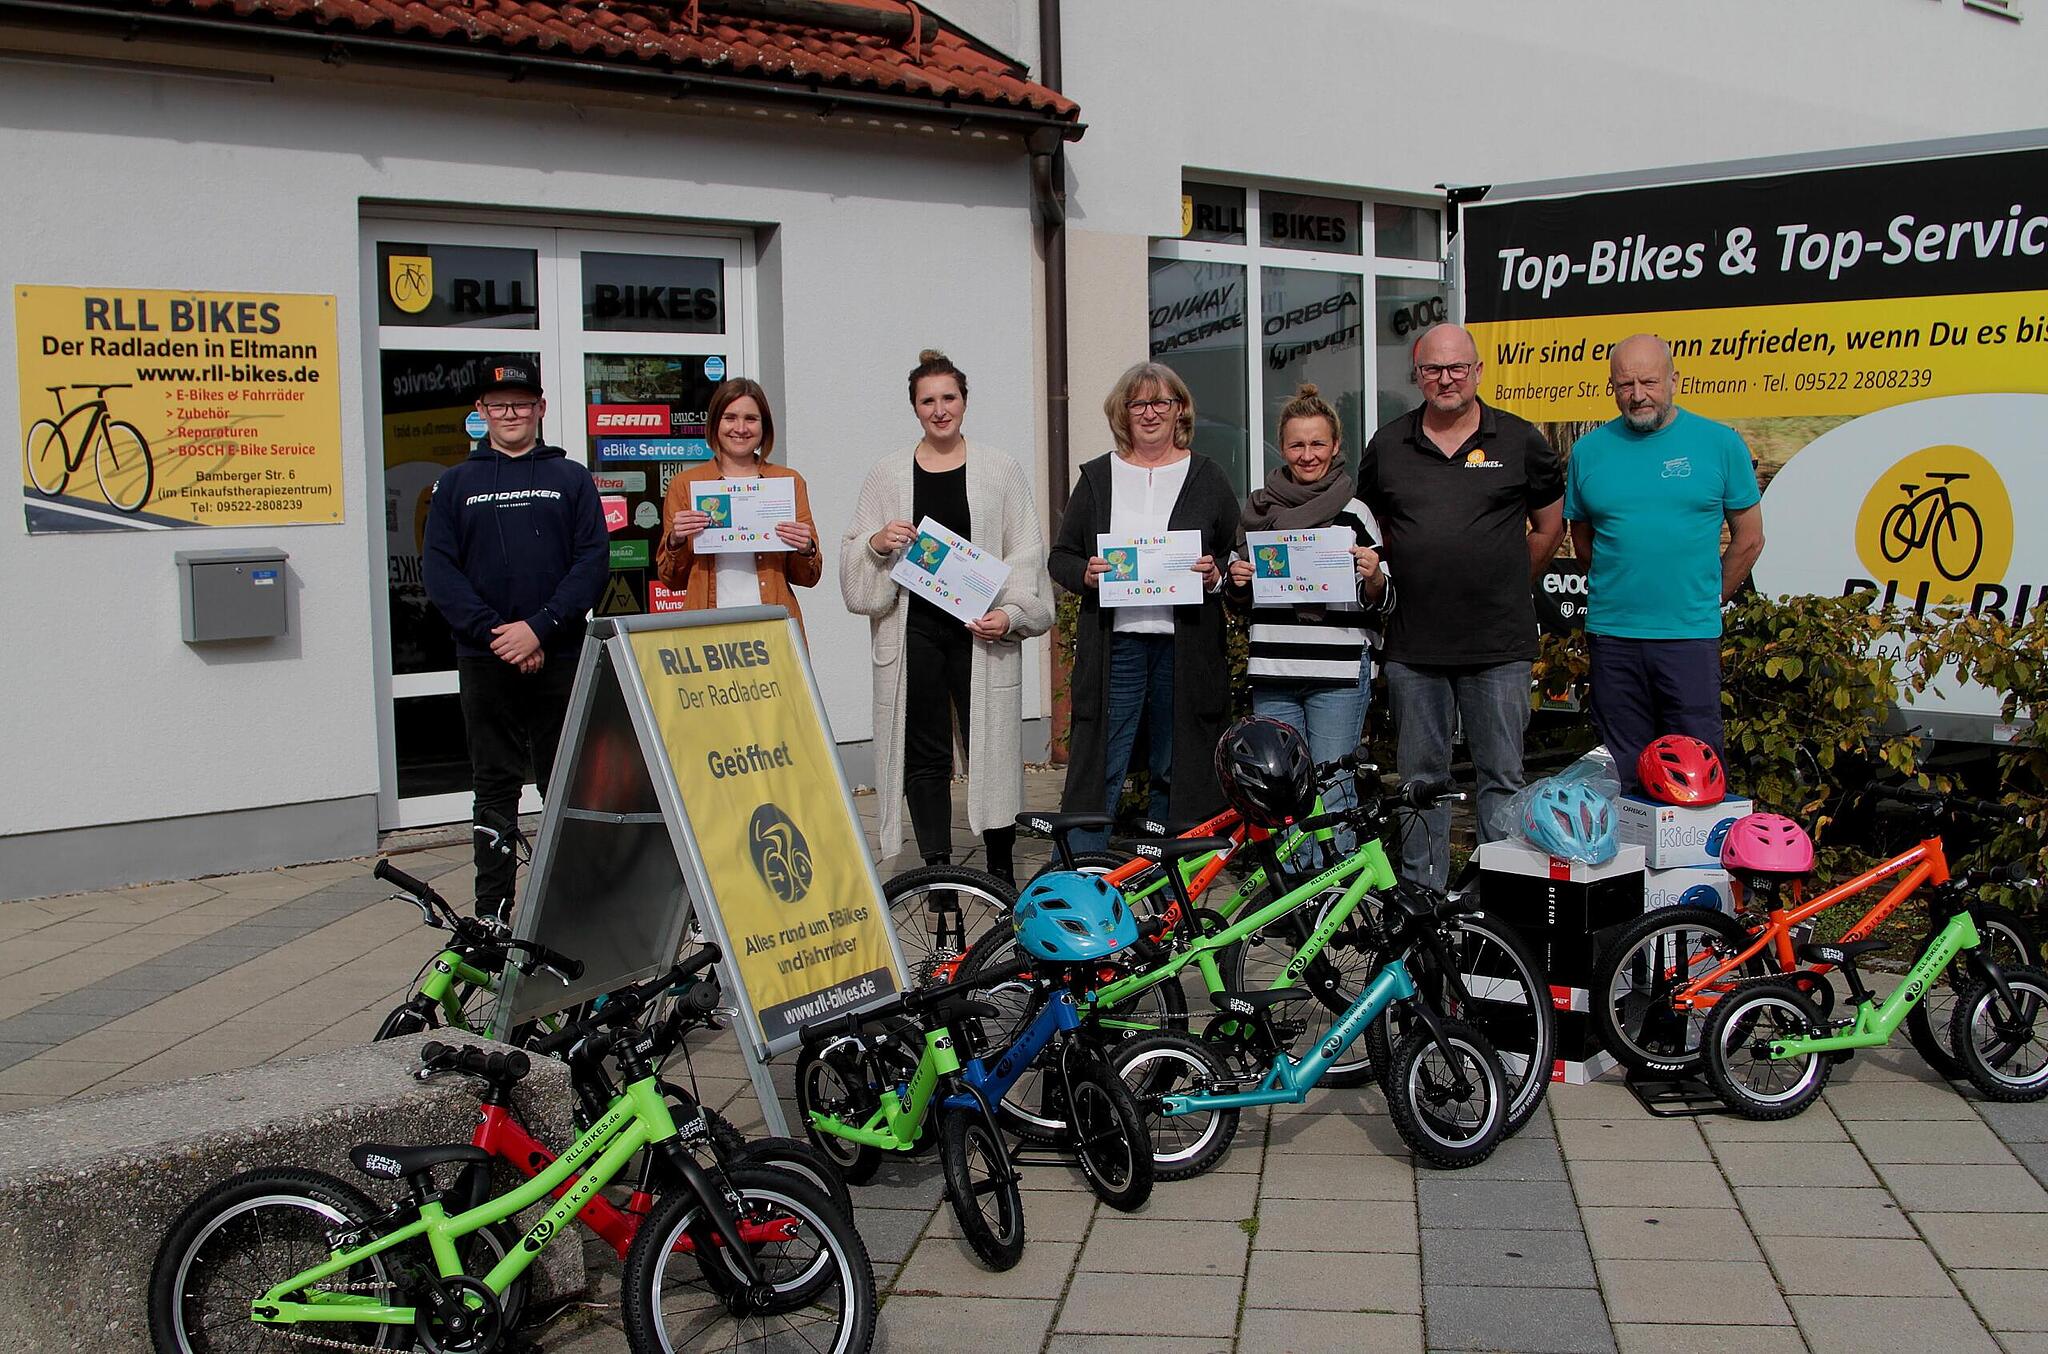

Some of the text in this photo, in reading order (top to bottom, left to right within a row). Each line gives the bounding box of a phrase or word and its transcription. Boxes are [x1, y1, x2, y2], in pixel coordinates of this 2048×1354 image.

[1197, 204, 1346, 242] RLL BIKES
[1498, 204, 2048, 299] Top-Bikes & Top-Servic
[454, 278, 718, 320] RLL BIKES
[1149, 282, 1235, 329] ONWAY
[1264, 291, 1357, 336] ORBEA
[85, 297, 280, 335] RLL BIKES
[42, 336, 317, 359] Der Radladen in Eltmann
[1151, 313, 1242, 356] RACEFACE
[1497, 343, 1534, 365] Wir
[1539, 338, 1587, 363] sind
[1592, 343, 1615, 360] er
[1710, 328, 1836, 361] zufrieden,
[1846, 328, 1920, 350] wenn
[1929, 321, 1968, 347] Du
[1977, 324, 2008, 345] es
[137, 365, 320, 382] www.rll-bikes.de
[1495, 383, 1574, 402] Bamberger
[1577, 381, 1600, 398] Str.
[1681, 376, 1747, 394] Eltmann
[1763, 373, 1789, 392] Tel.
[1794, 372, 1847, 391] 09522
[1853, 369, 1932, 389] 2808239
[177, 388, 305, 401] E-Bikes & Fahrräder
[177, 407, 230, 419] Zubehör
[596, 414, 661, 426] SRAM
[178, 427, 258, 440] Reparaturen
[179, 444, 315, 456] BOSCH E-Bike Service
[603, 443, 684, 456] eBike Service
[196, 469, 295, 483] Bamberger Str. 6
[158, 484, 332, 500] (im Einkaufstherapiezentrum)
[190, 500, 303, 513] Tel: 09522-2808239
[466, 489, 561, 506] MONDRAKER
[658, 640, 770, 676] RLL BIKES
[678, 680, 782, 710] Der Radladen
[707, 741, 793, 779] Geöffnet
[1622, 805, 1648, 817] ORBEA
[1660, 826, 1708, 848] Kids
[1548, 887, 1556, 924] DEFEND
[1645, 888, 1679, 907] ids
[745, 933, 776, 956] Alles
[779, 921, 807, 945] rund
[809, 919, 830, 936] um
[1307, 921, 1335, 954] bikes
[784, 978, 876, 1024] www.rll-bikes.de
[565, 1113, 621, 1164] RLL-BIKES.de
[308, 1190, 348, 1213] KENDA
[555, 1175, 598, 1219] bikes
